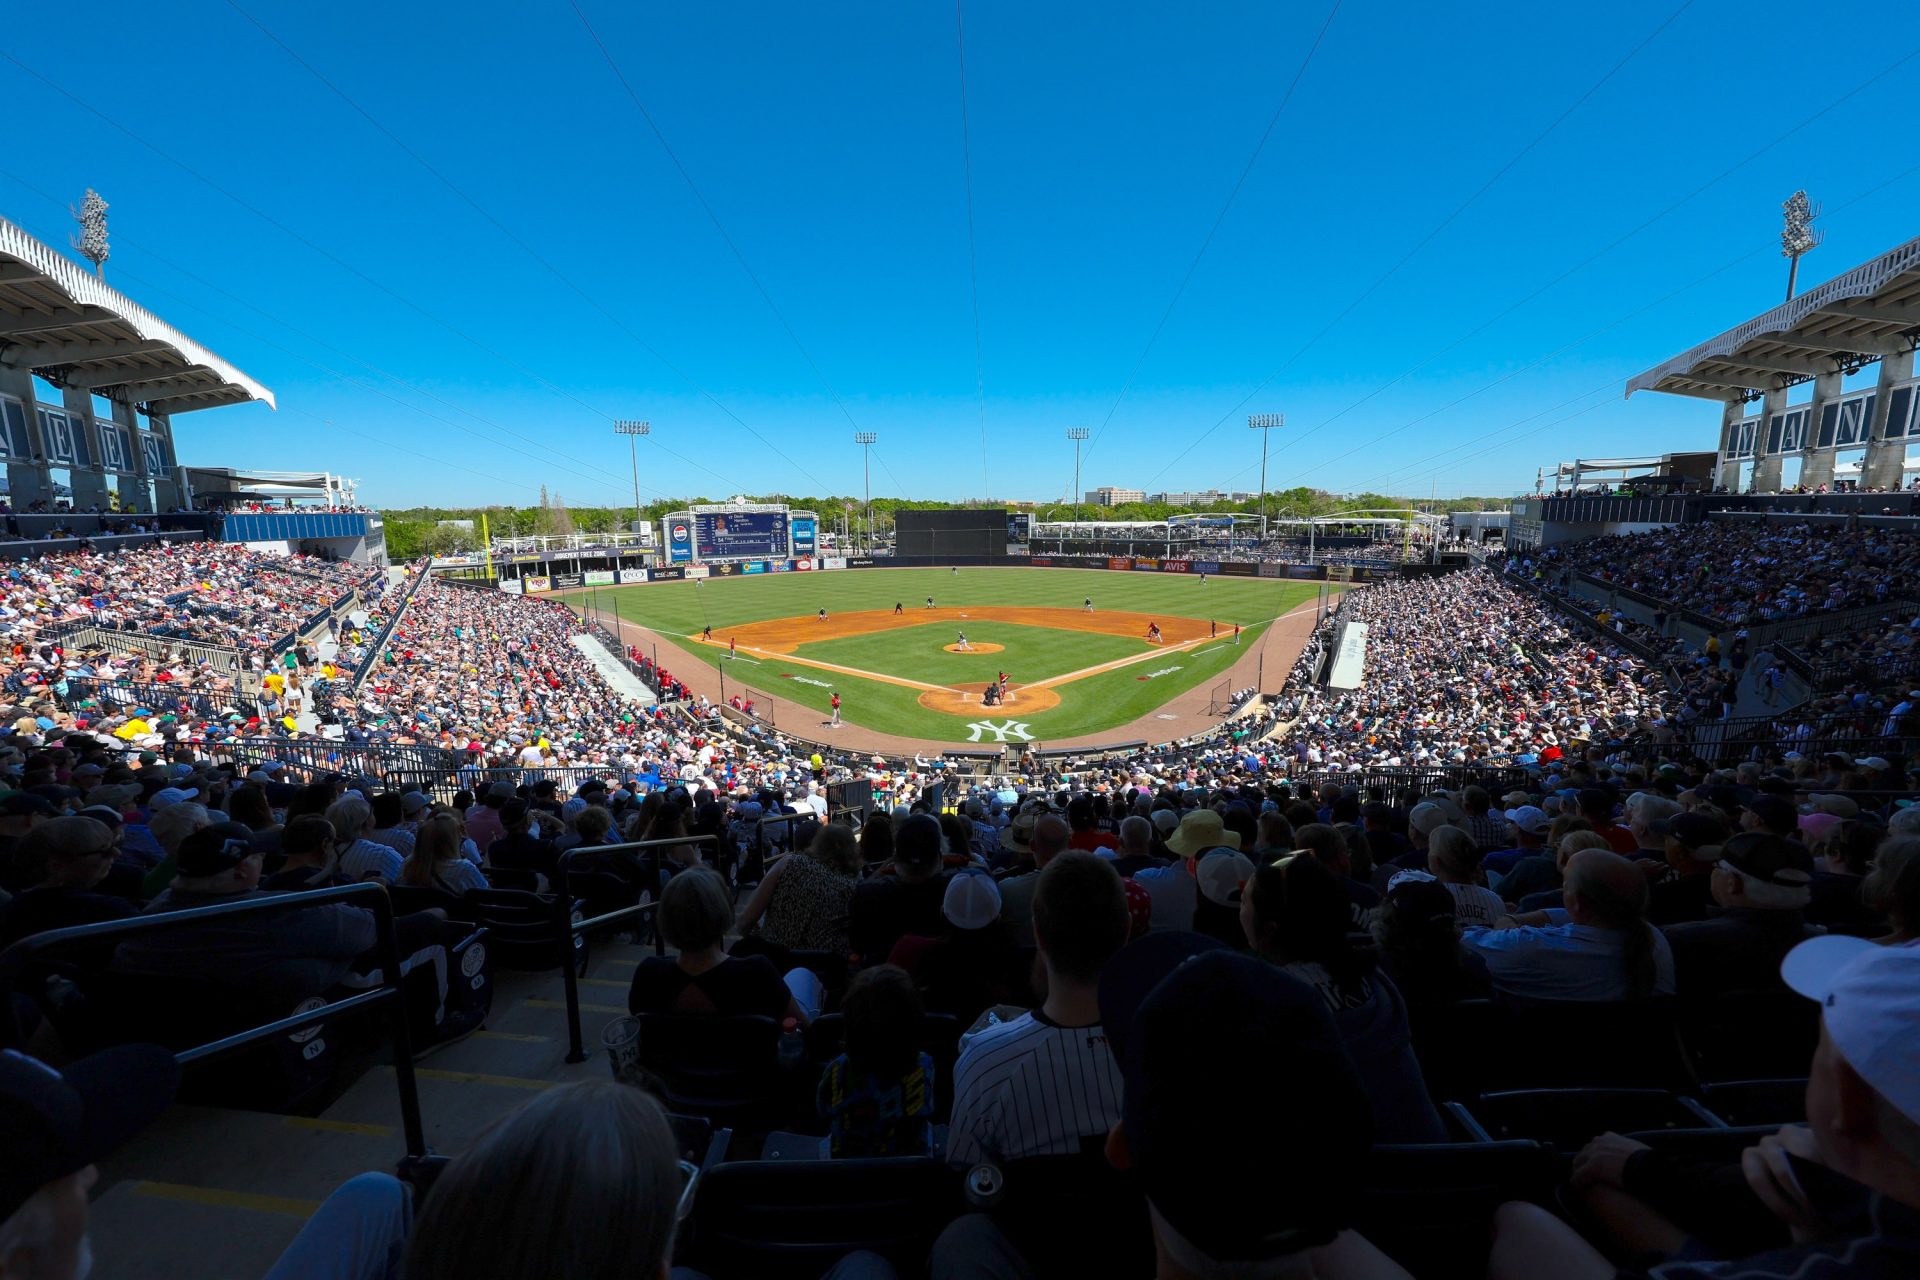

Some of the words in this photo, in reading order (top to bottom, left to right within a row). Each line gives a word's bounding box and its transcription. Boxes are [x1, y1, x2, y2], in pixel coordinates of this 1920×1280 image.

[554, 551, 579, 560] JUDGEMENT
[580, 550, 593, 558] FREE
[1164, 562, 1186, 571] AVIS
[966, 720, 1036, 742] NY
